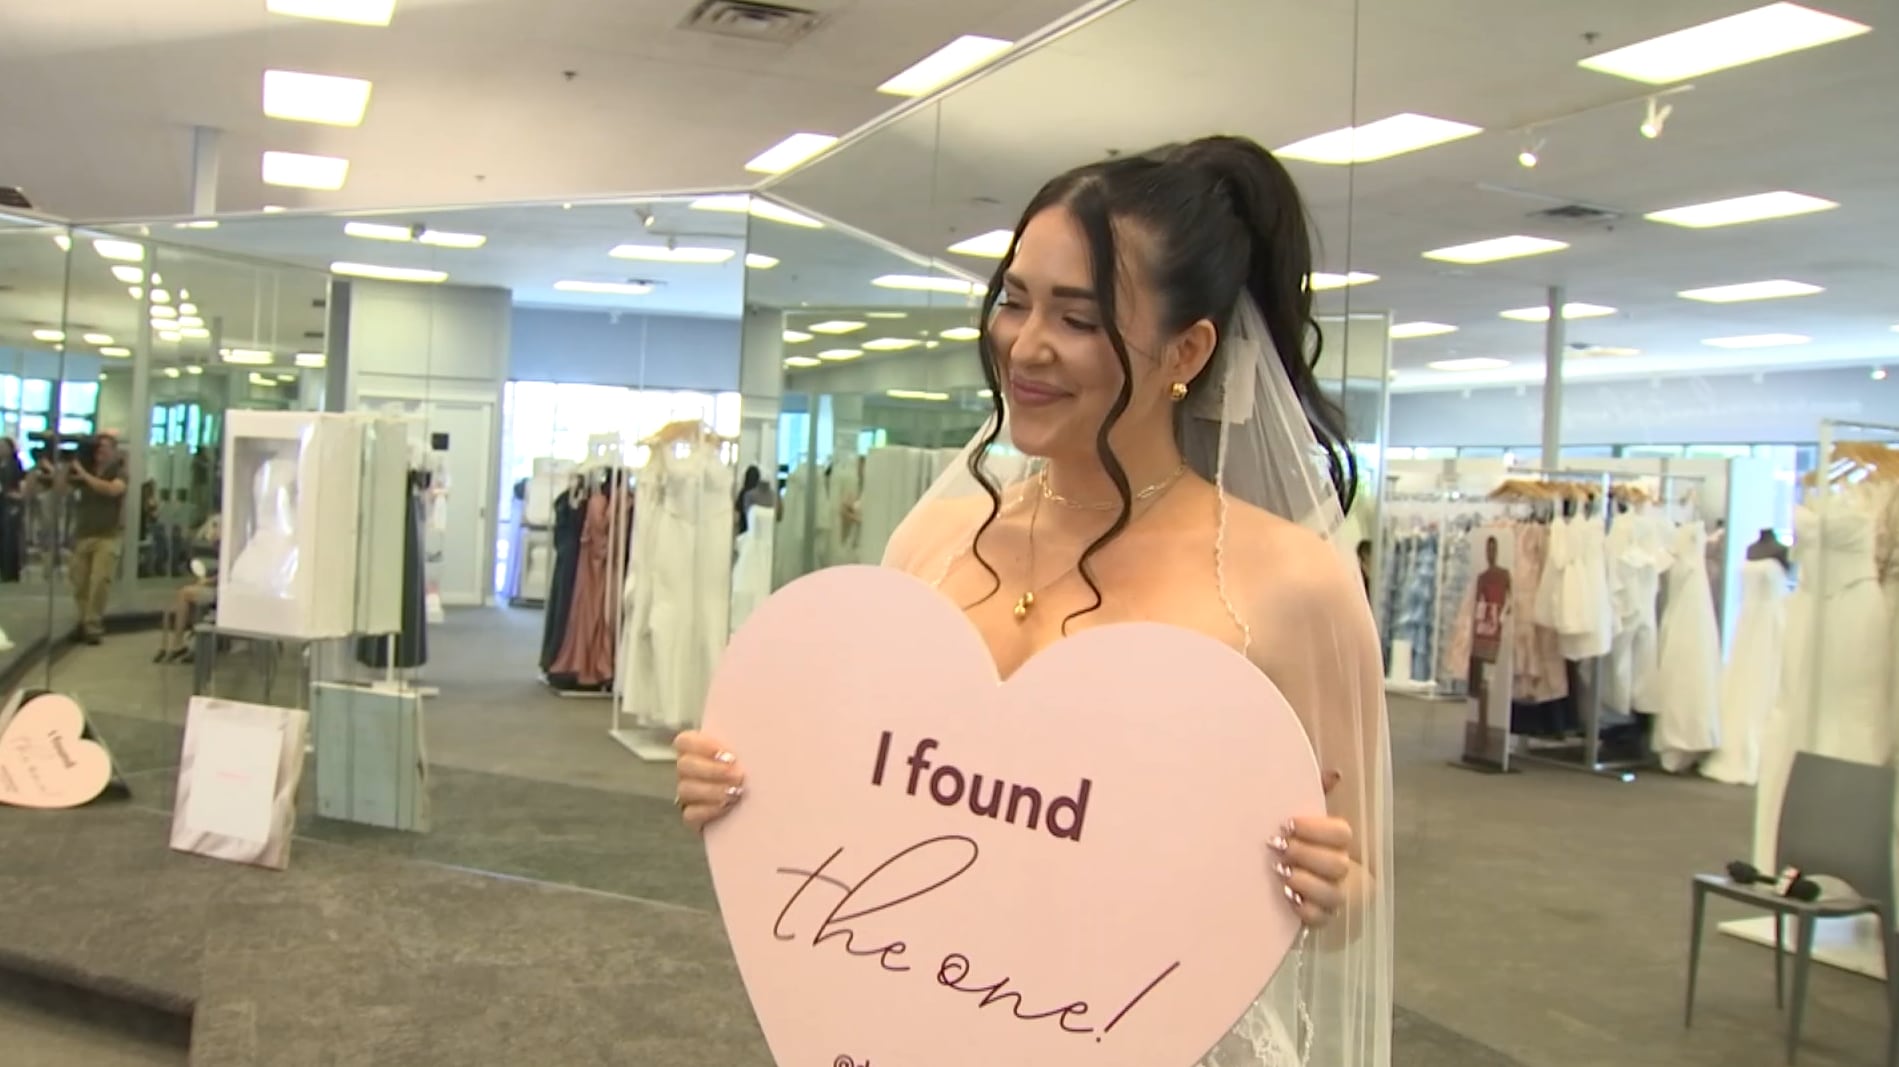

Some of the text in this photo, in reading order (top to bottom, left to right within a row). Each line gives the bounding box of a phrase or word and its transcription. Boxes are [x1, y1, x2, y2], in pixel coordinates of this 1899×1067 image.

[871, 731, 1093, 842] I found
[773, 834, 1181, 1044] the one!
